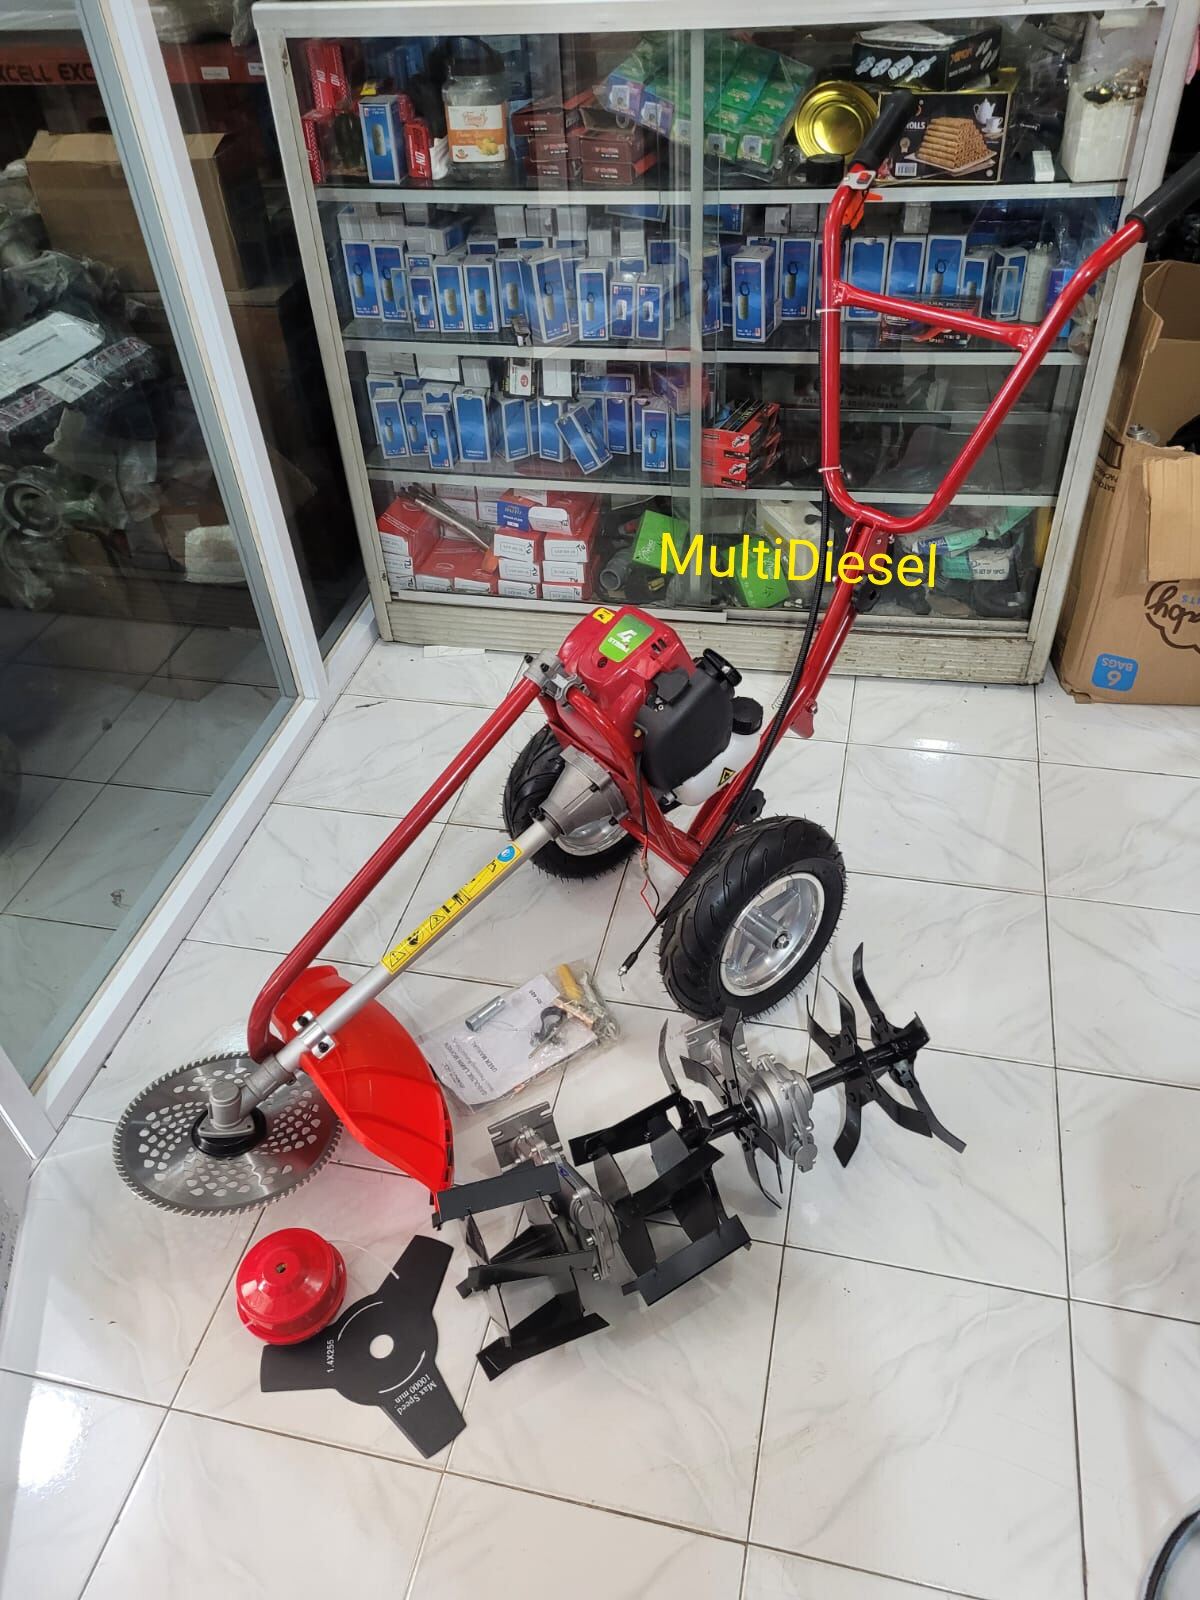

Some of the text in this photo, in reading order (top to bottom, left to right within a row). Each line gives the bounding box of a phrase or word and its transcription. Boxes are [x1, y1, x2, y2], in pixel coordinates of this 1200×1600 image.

[1102, 657, 1133, 673] BAGS
[1107, 670, 1122, 687] 6
[326, 1339, 335, 1373] 1.4X255
[409, 1373, 431, 1394] 10000
[396, 1380, 437, 1416] Max Speed
